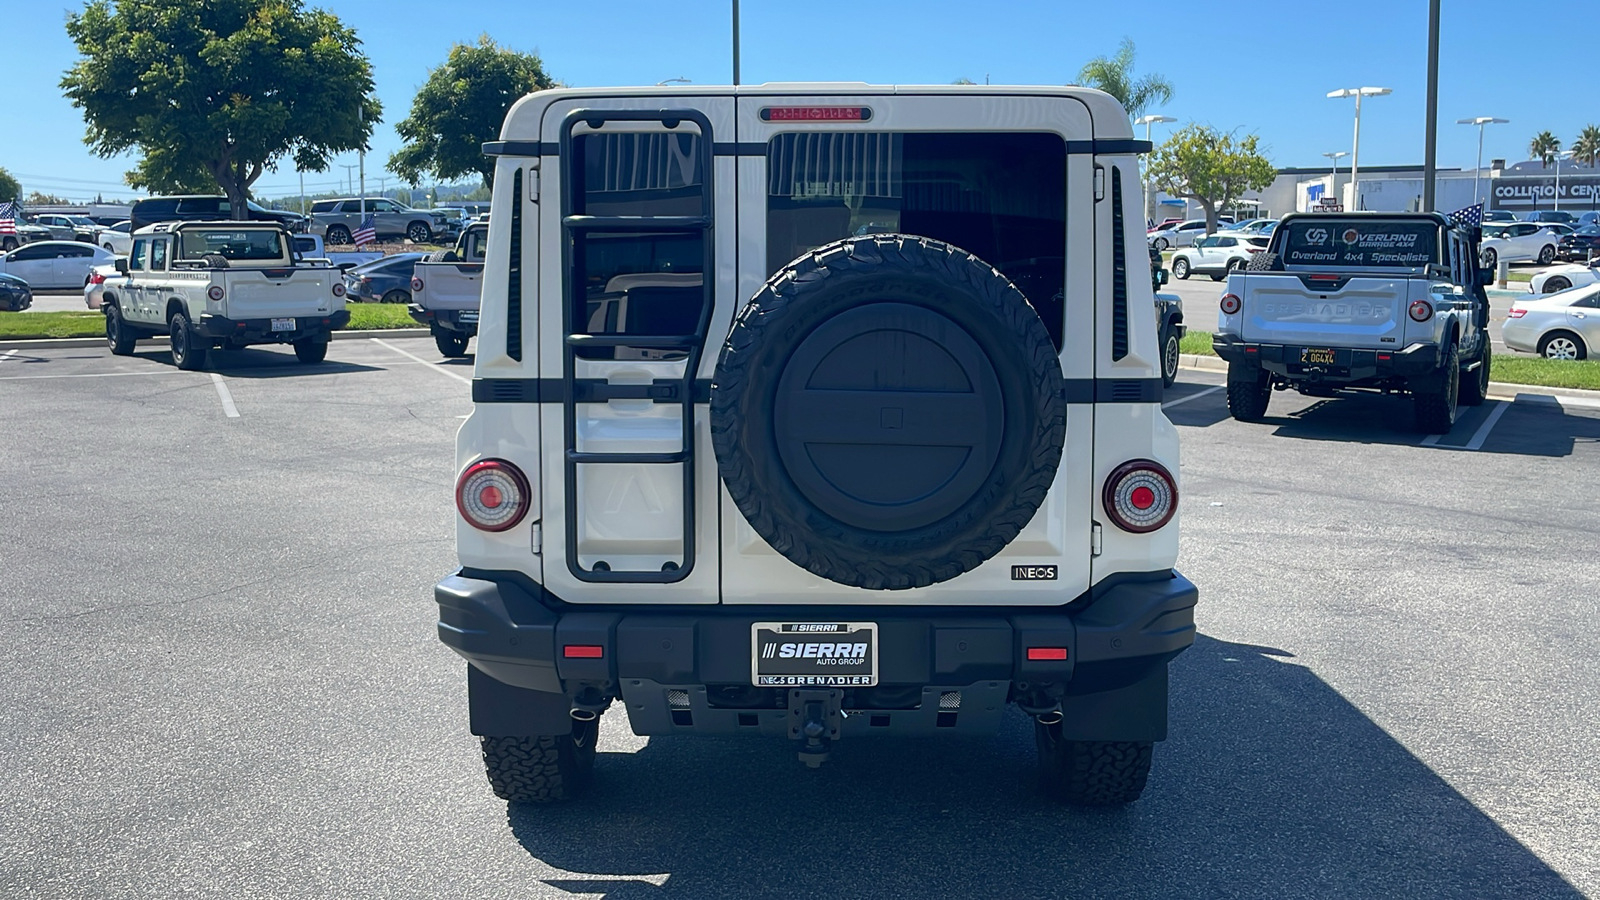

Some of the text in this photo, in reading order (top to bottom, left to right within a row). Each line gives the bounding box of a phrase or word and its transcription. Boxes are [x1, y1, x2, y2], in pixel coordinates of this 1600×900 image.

[1495, 185, 1566, 197] COLLISION
[1291, 251, 1430, 263] Overland 4x4 Specialists
[1264, 303, 1385, 317] GRENADIER
[1015, 567, 1055, 579] INEOS
[798, 624, 838, 632] SIERRA
[778, 643, 868, 659] SIERRA
[787, 676, 870, 685] GRENADIER
